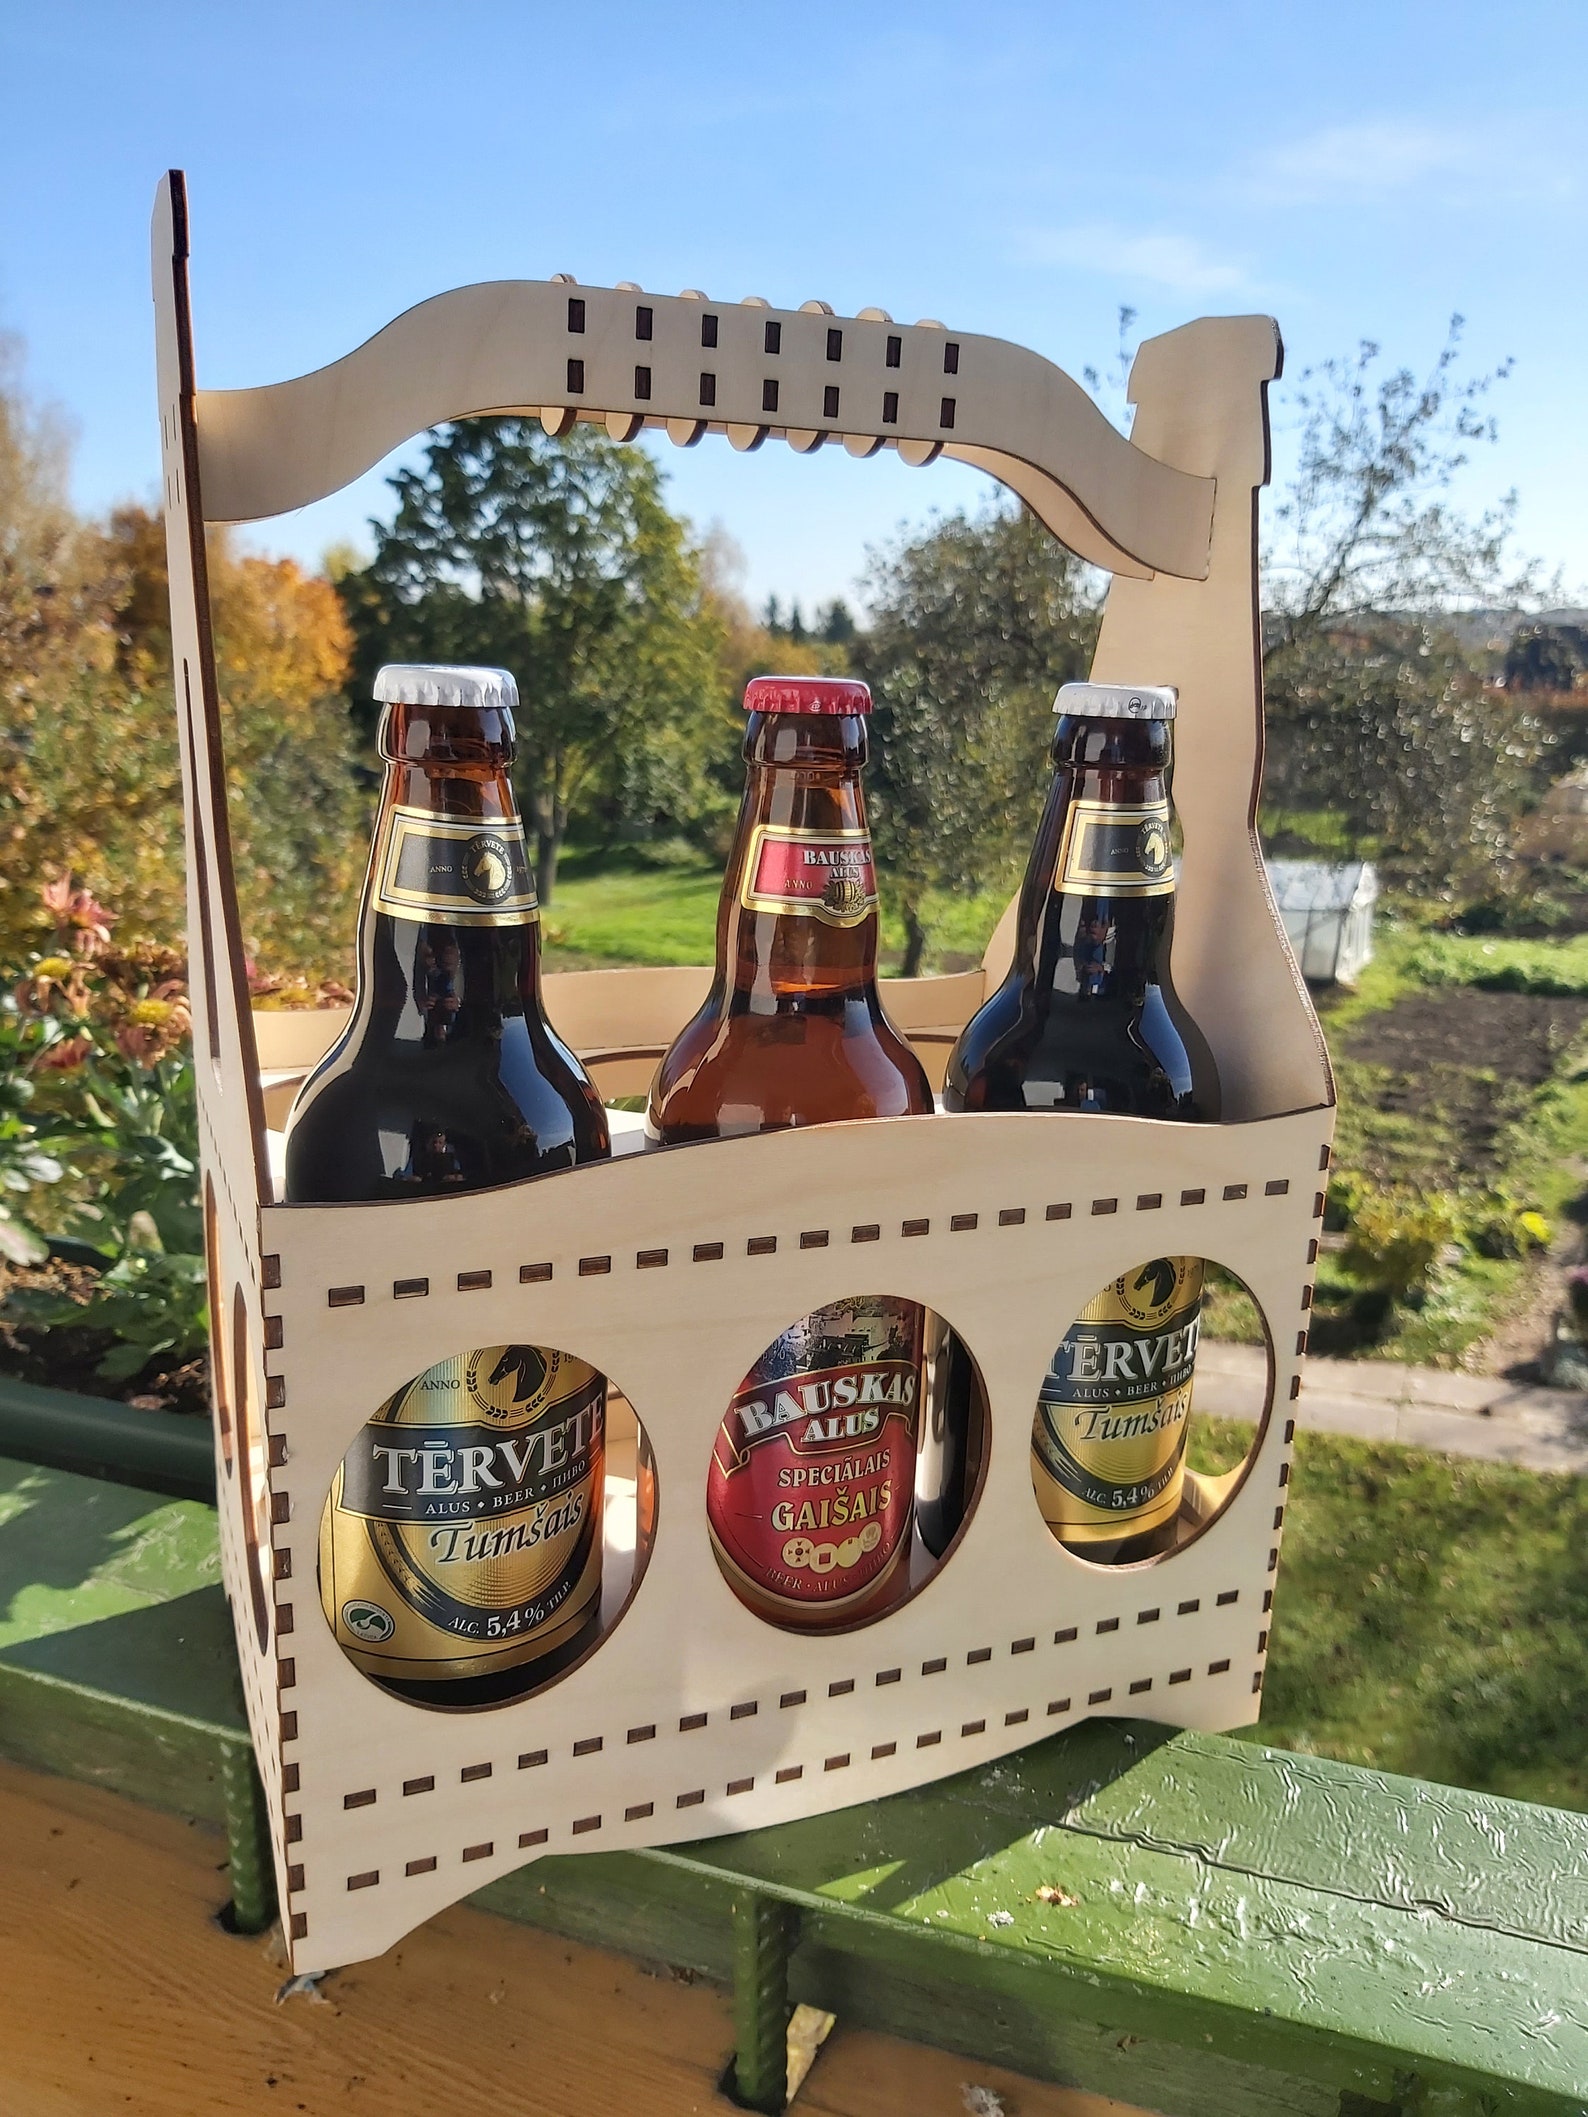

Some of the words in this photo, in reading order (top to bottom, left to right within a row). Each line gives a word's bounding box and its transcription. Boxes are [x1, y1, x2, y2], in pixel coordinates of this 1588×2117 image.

[803, 849, 871, 866] BAUSKAS
[430, 865, 453, 873] ANNO
[829, 866, 860, 879] ALUS
[420, 1378, 461, 1391] ANNO
[1072, 1387, 1110, 1398] ALUS
[1127, 1381, 1158, 1396] BEER
[734, 1371, 915, 1438] BAUSKAS
[800, 1406, 880, 1443] ALUS
[424, 1501, 471, 1516] ALUS
[492, 1487, 535, 1508] BEER
[551, 1460, 587, 1489] ПИВО
[771, 1479, 893, 1532] GAIŠAIS
[430, 1490, 584, 1563] Tumšais
[765, 1568, 802, 1590] BEER
[448, 1616, 480, 1634] ALC.
